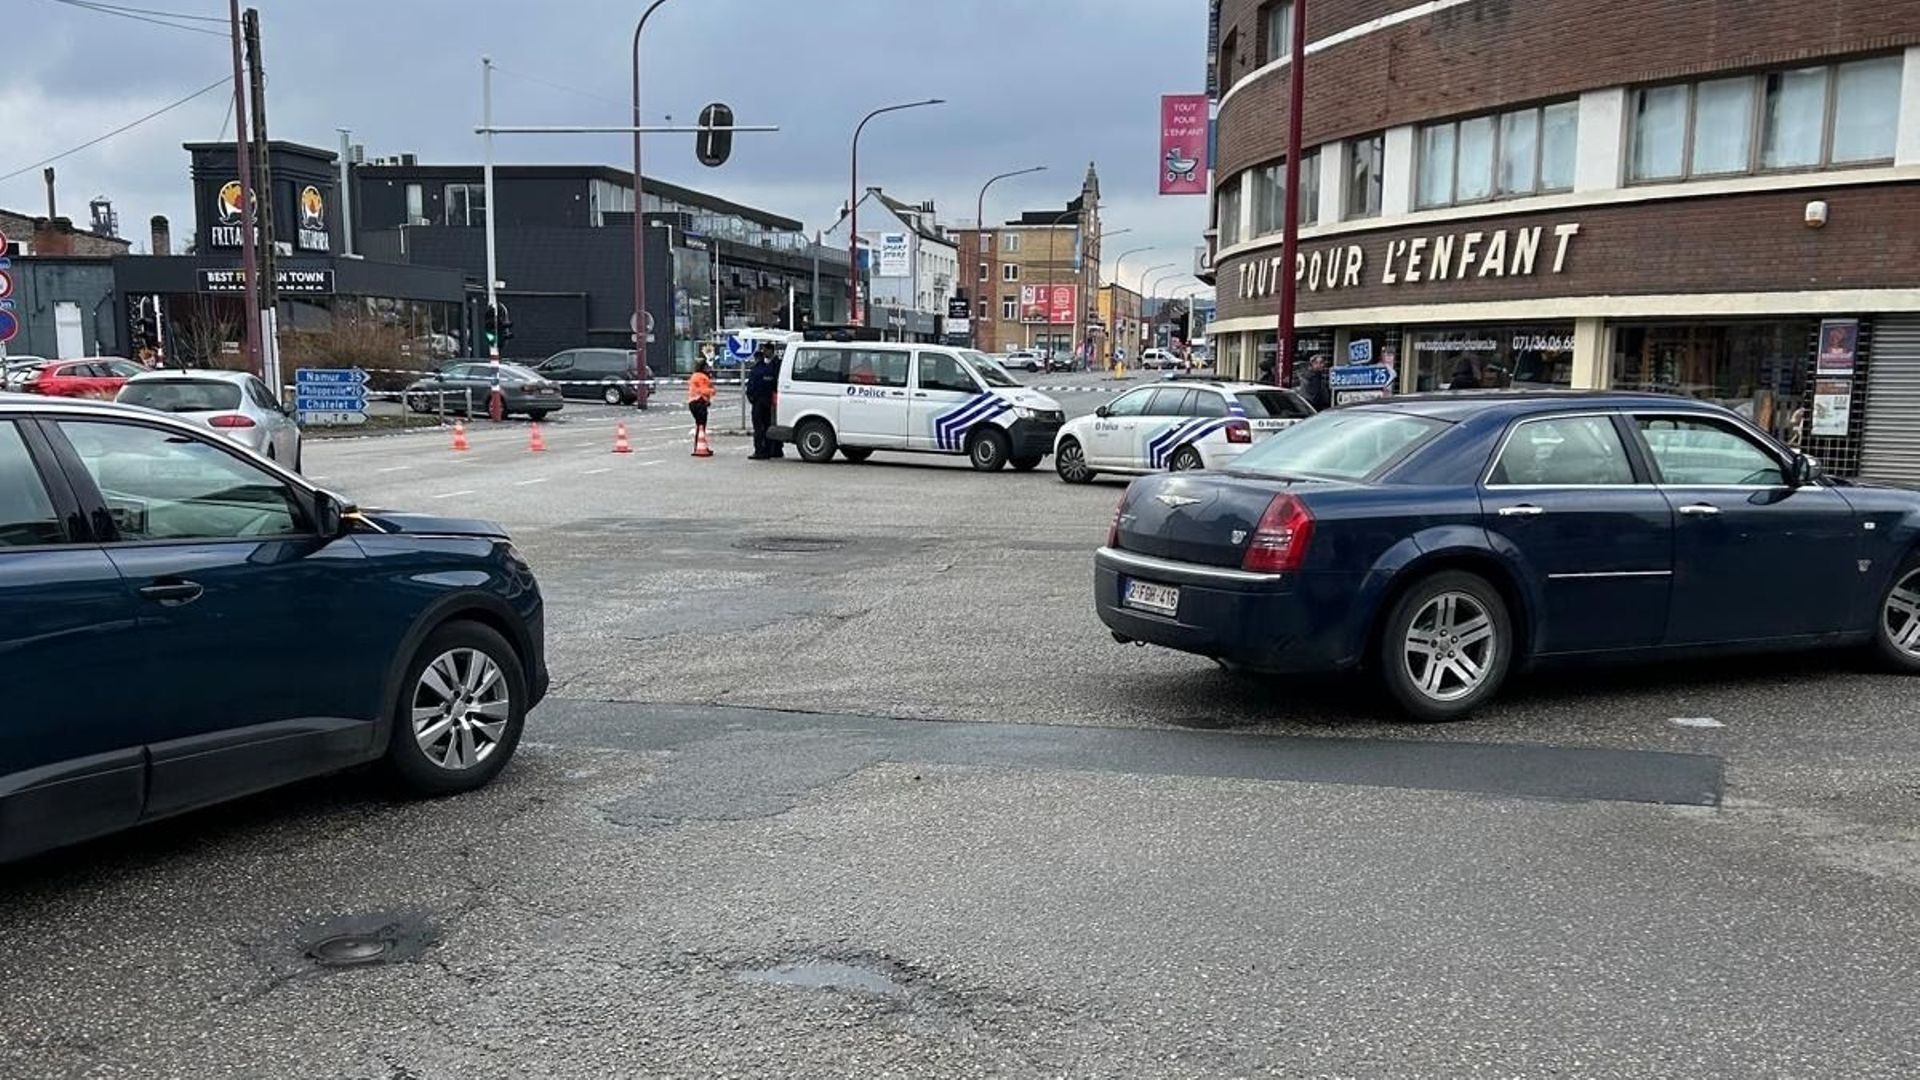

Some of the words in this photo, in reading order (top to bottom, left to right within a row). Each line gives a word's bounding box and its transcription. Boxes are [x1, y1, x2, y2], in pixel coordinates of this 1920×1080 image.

[1173, 103, 1197, 112] TOUT
[1173, 116, 1196, 124] POUR
[1164, 128, 1204, 137] L'ENFANT
[1238, 256, 1281, 299] TOUT
[1295, 245, 1364, 292] POUR
[1381, 223, 1580, 285] L'ENFANT
[207, 271, 233, 282] BEST
[289, 272, 325, 283] TOWN
[306, 371, 341, 381] Namur
[1331, 370, 1372, 385] Beaumont
[1374, 369, 1387, 384] 25
[858, 387, 886, 397] Police
[355, 400, 362, 409] 6
